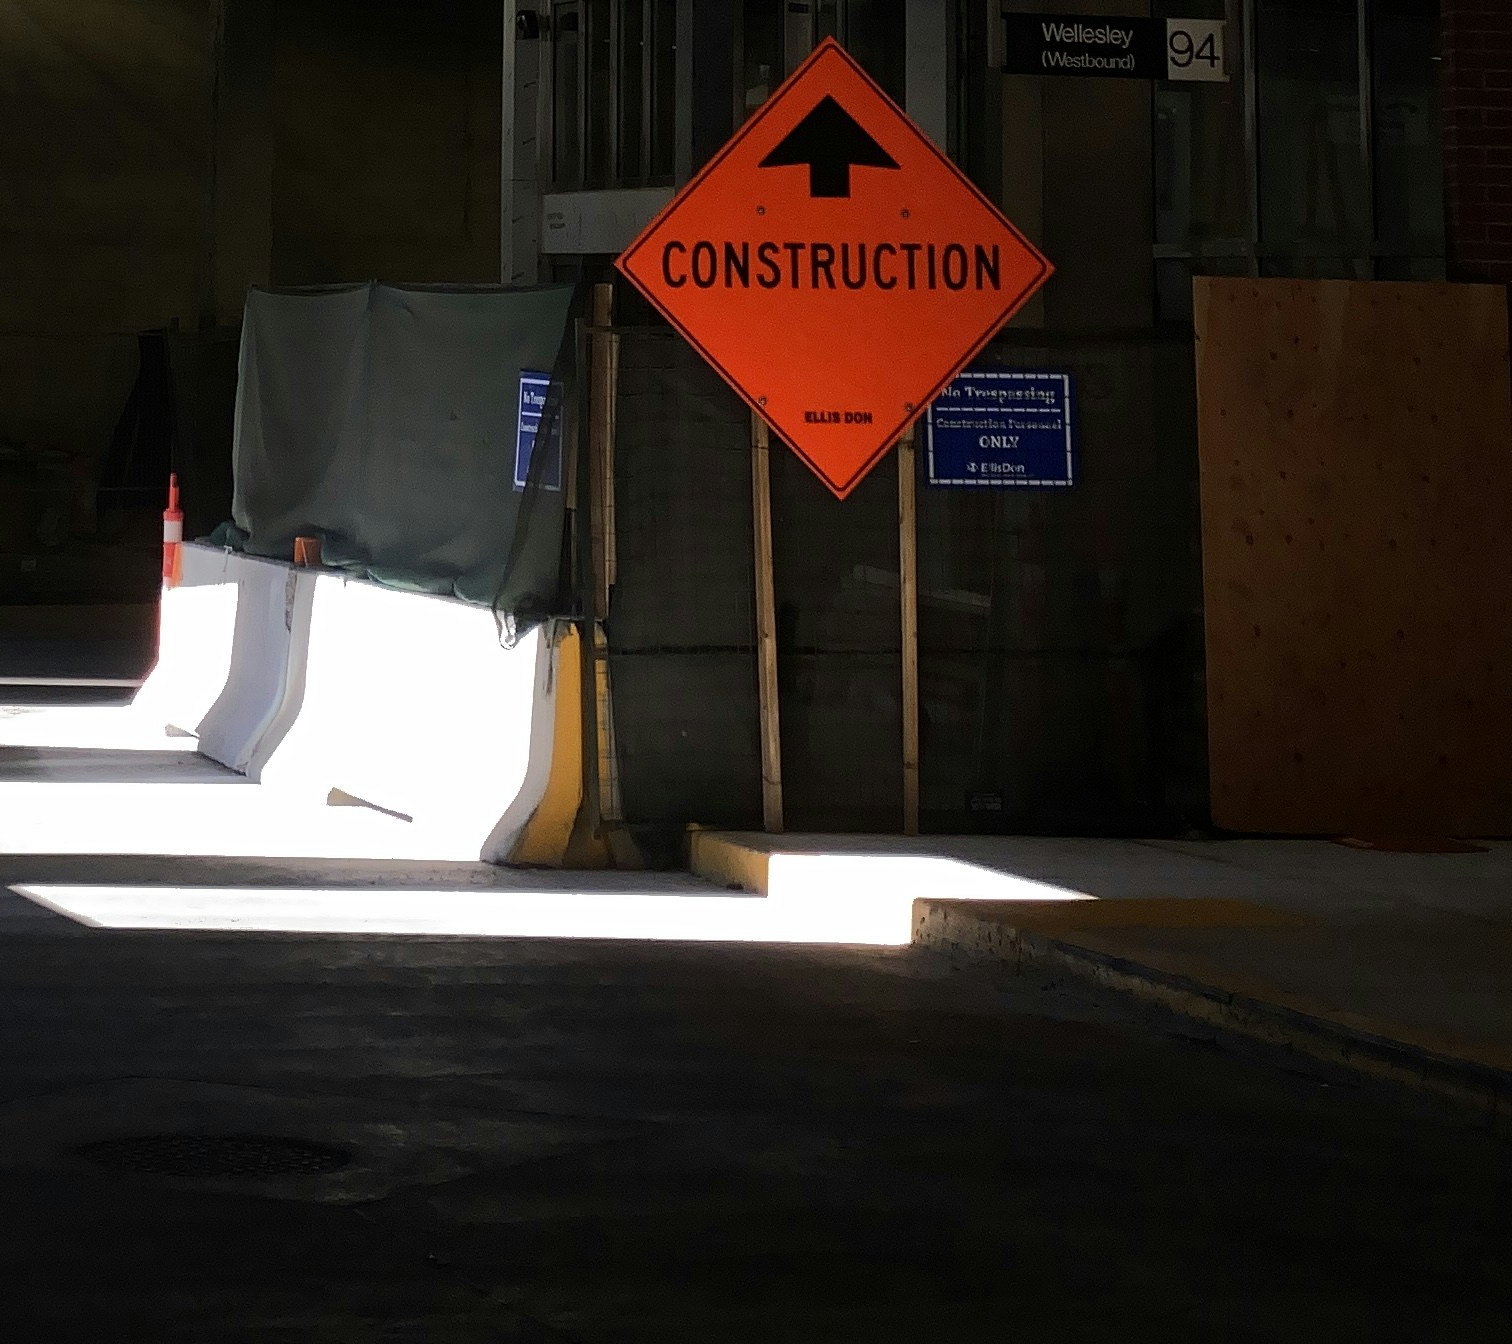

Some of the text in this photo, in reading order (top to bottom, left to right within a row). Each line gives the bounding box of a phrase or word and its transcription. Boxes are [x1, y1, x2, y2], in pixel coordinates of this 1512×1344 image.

[1041, 22, 1134, 48] Wellesley
[1169, 30, 1220, 68] 94
[1041, 50, 1135, 71] (Westbound)
[662, 241, 1001, 291] CONSTRUCTION
[805, 411, 873, 424] ELLIS DON
[978, 435, 1020, 449] ONLY
[981, 462, 1025, 474] EllisDon
